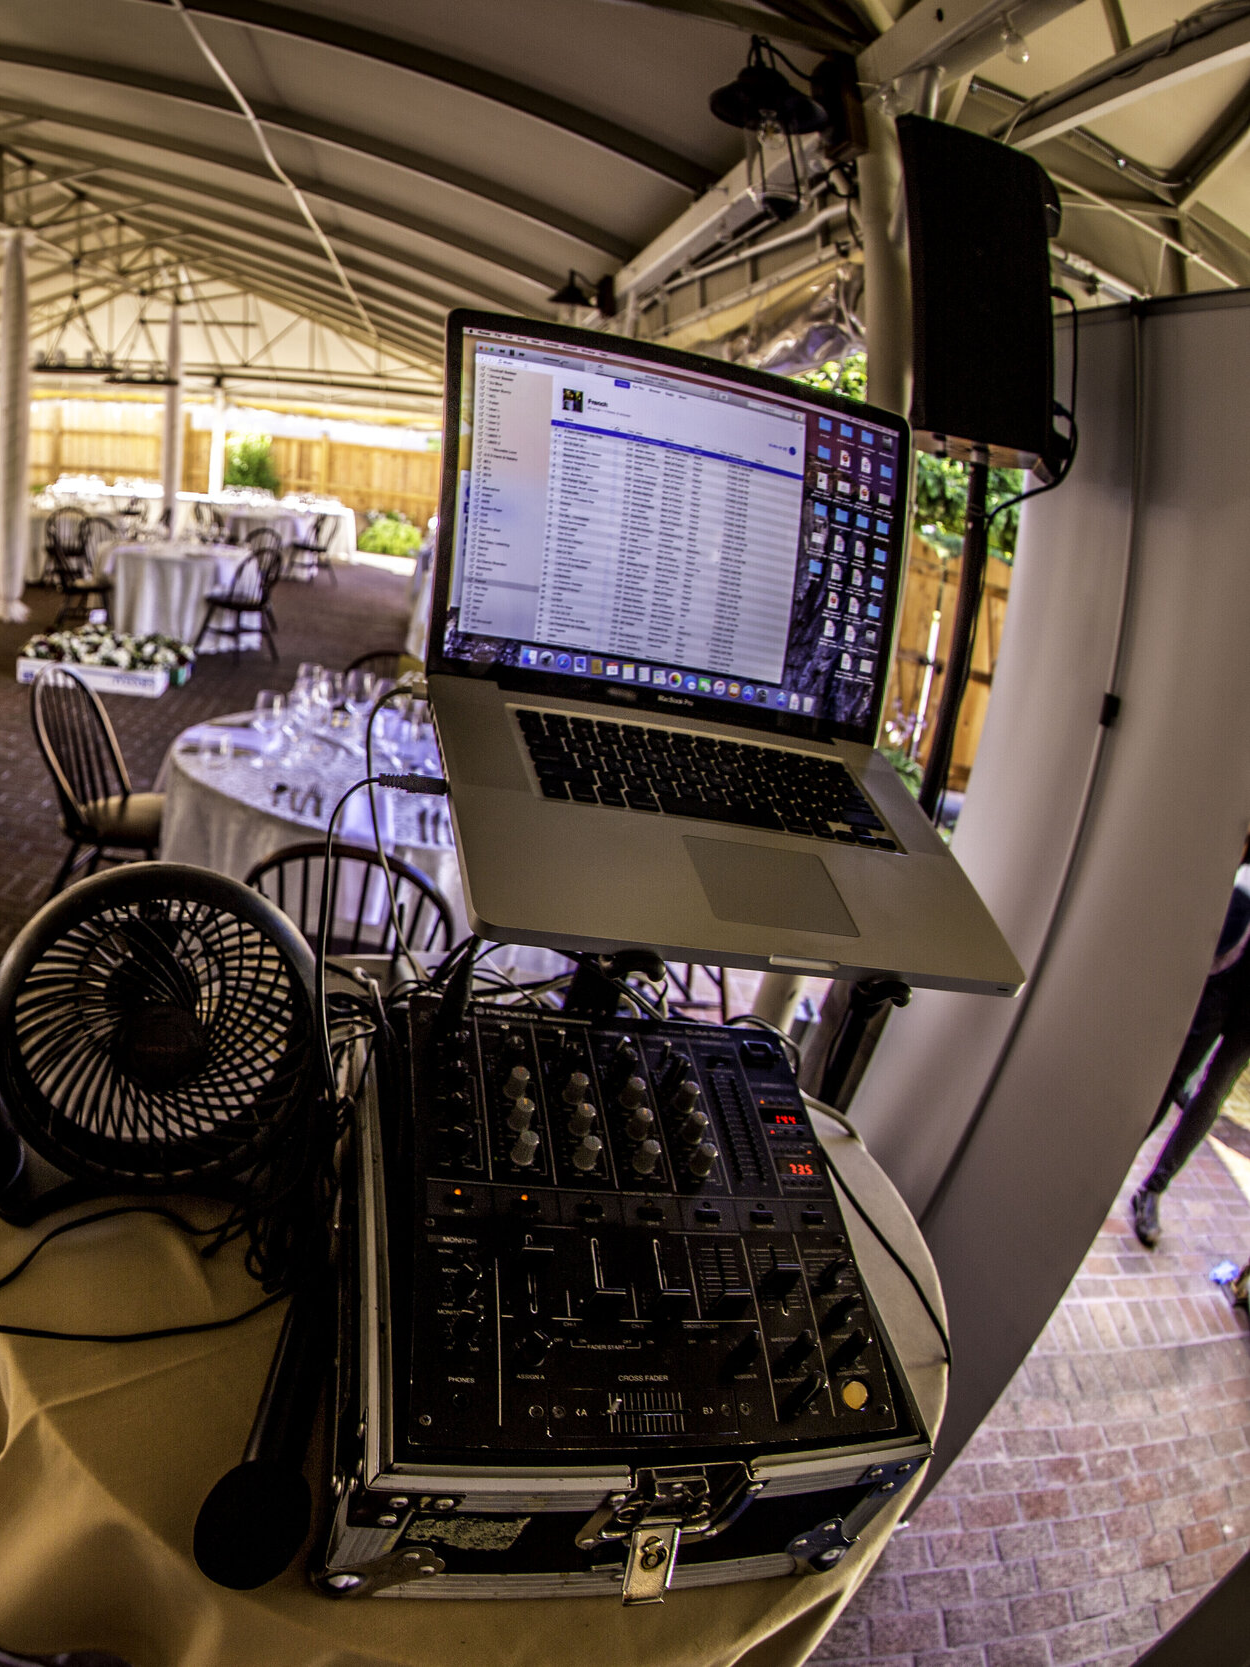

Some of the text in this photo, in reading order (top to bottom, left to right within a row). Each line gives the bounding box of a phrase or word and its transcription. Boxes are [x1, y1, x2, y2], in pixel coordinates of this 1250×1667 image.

[587, 398, 609, 408] French
[657, 694, 695, 707] MacBook Pro
[442, 1236, 478, 1244] MONITOR
[447, 1376, 475, 1384] PHONES
[617, 1374, 669, 1382] CROSS FADER
